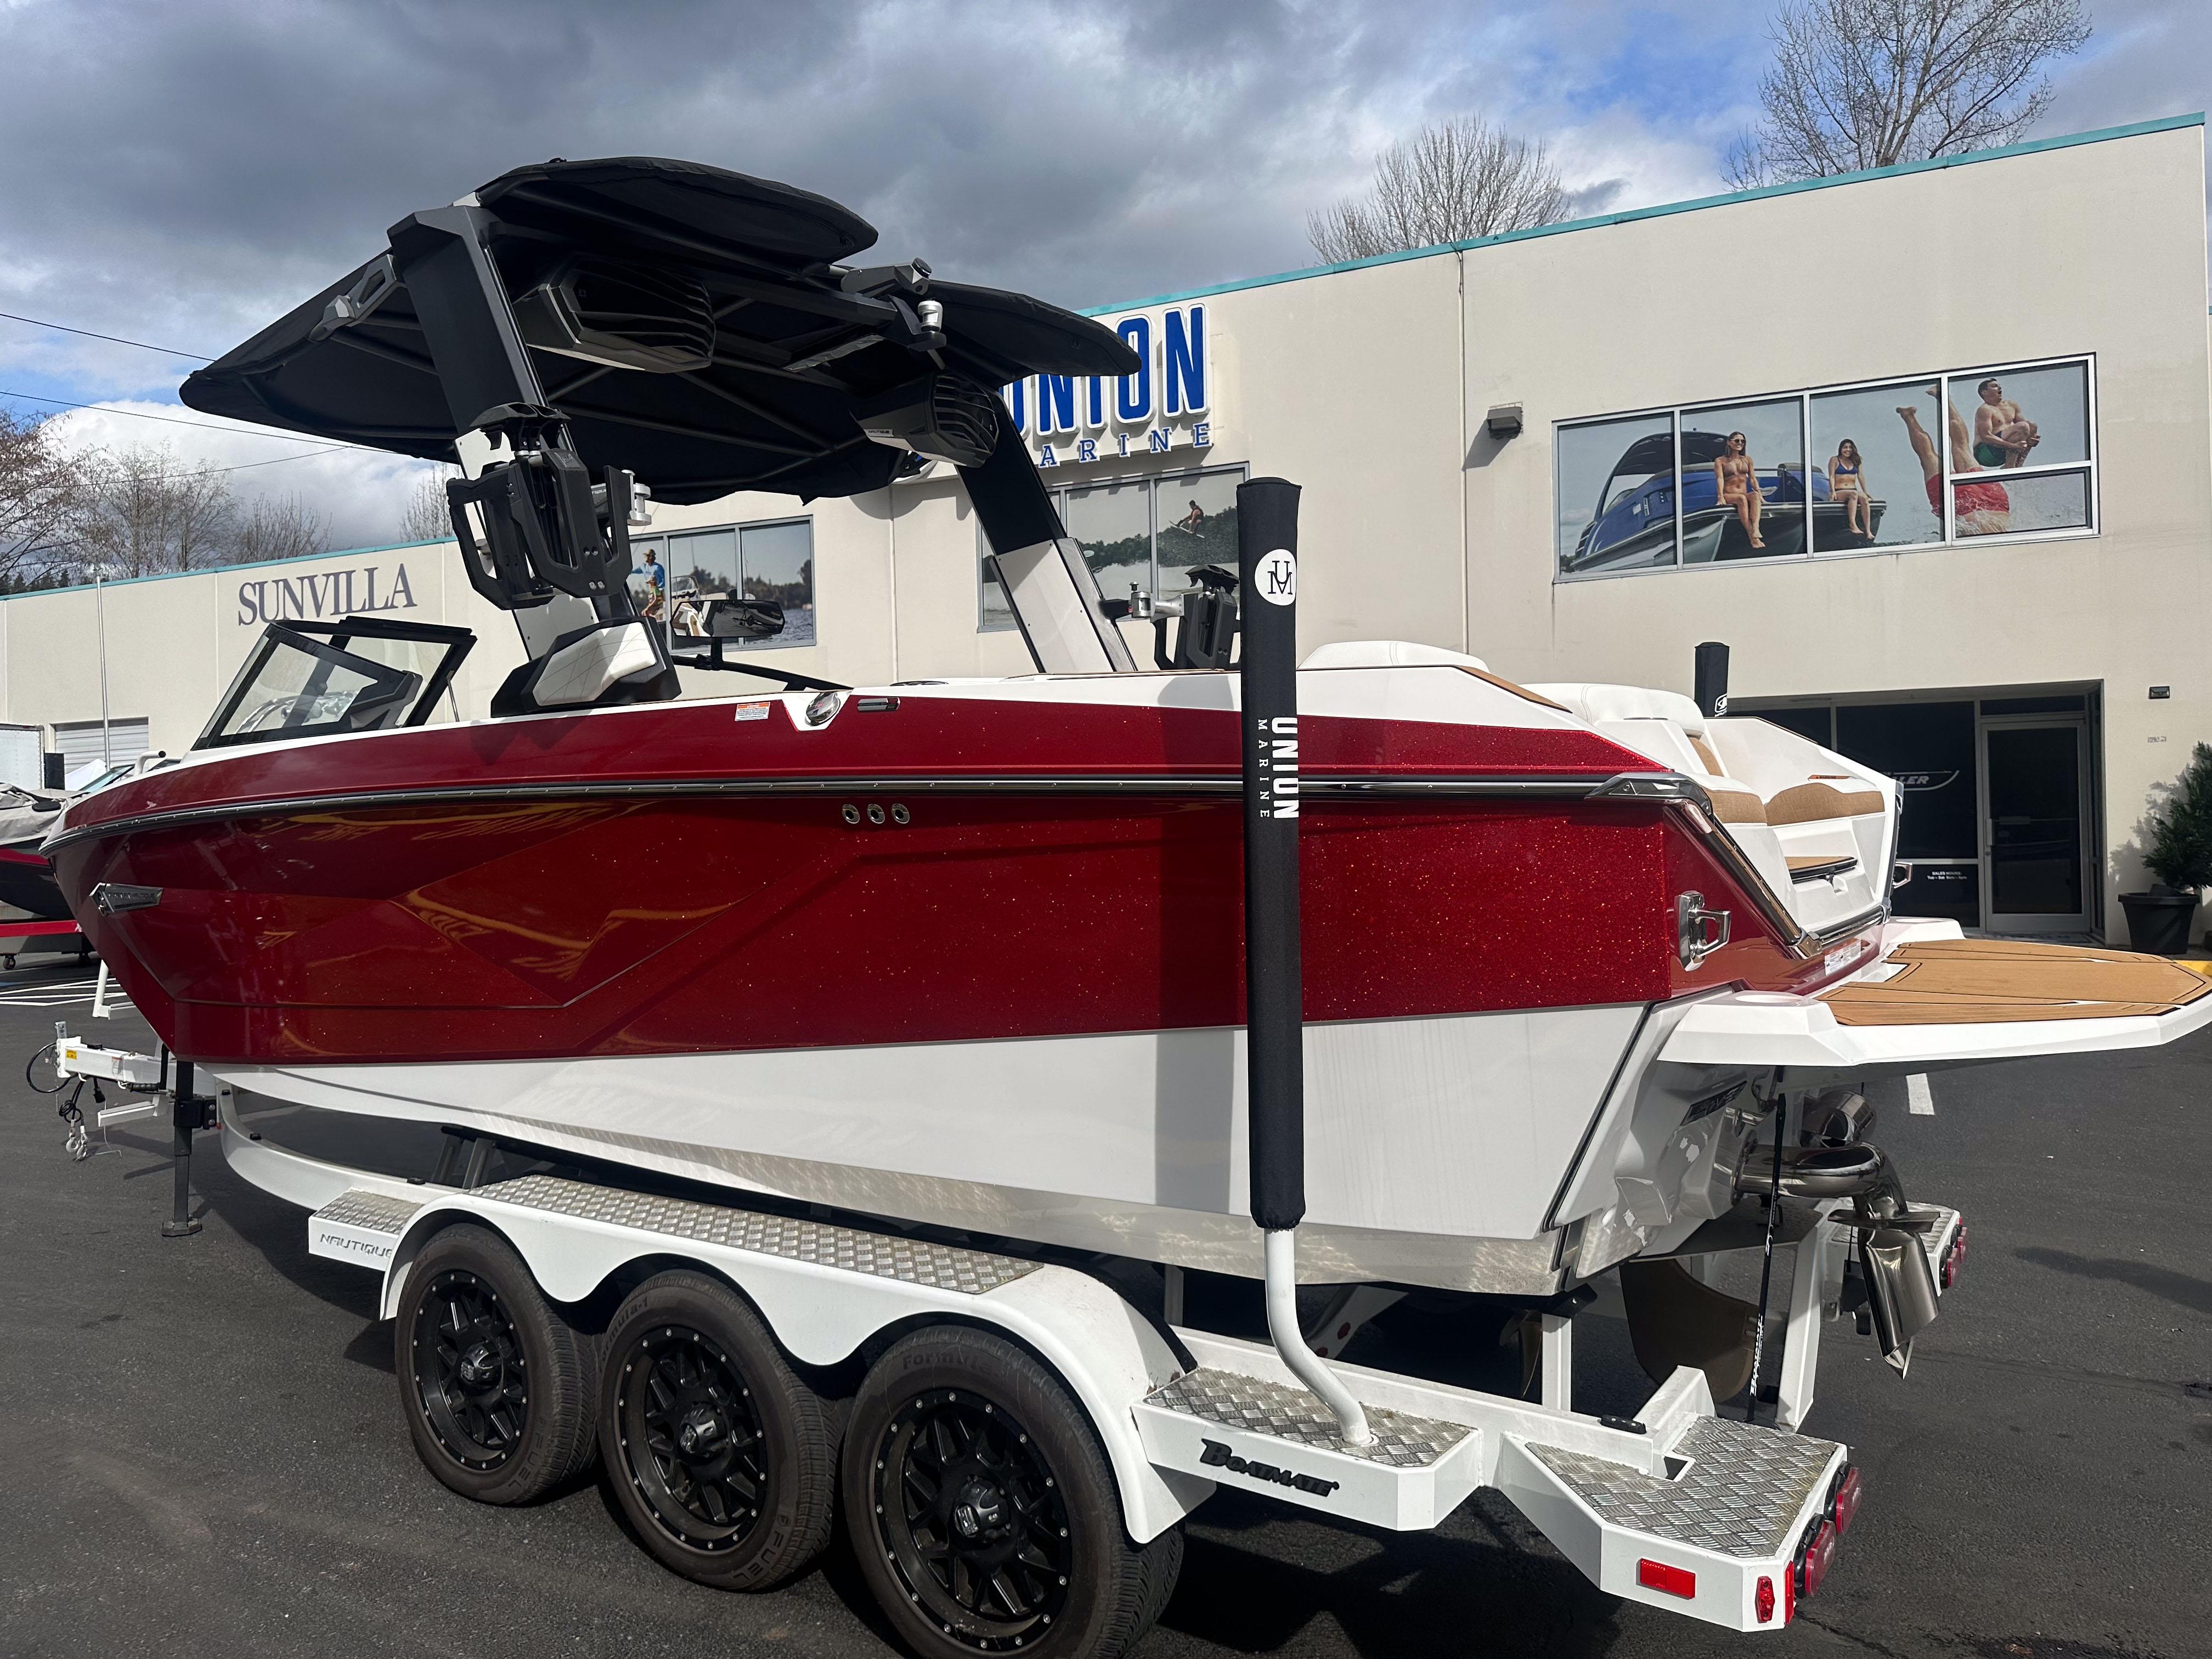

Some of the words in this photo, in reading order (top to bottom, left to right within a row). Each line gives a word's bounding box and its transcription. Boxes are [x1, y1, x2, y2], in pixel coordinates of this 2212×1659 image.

[999, 303, 1209, 436] NION
[1039, 422, 1211, 468] ARINE
[238, 563, 417, 627] SUNVILLA
[1258, 719, 1270, 817] MARINE
[1271, 717, 1299, 819] UNION
[1892, 775, 1930, 785] LER
